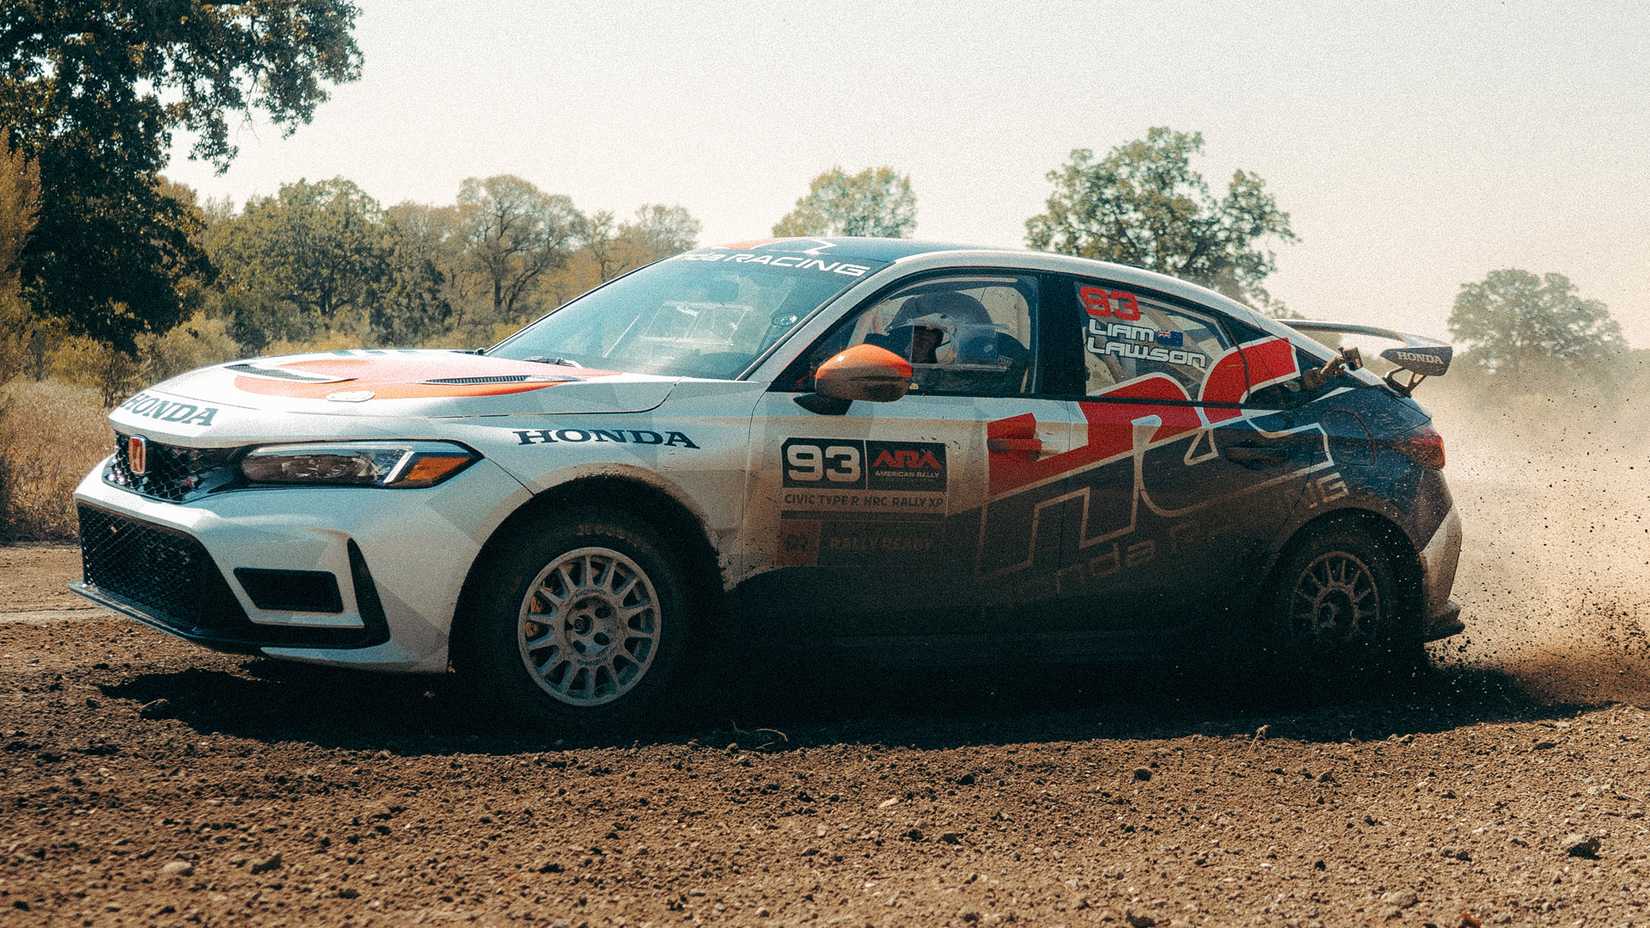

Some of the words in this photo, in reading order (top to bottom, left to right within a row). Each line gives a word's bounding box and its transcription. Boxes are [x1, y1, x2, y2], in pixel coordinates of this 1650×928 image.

[723, 253, 871, 277] RACING
[1080, 285, 1141, 322] 93
[1088, 319, 1156, 343] LIAM
[1087, 336, 1208, 368] LAWSON
[1397, 351, 1445, 366] HONDA
[119, 392, 219, 427] HONDA
[512, 428, 701, 450] HONDA
[787, 444, 861, 482] 93
[874, 470, 915, 478] AMERICAN
[916, 471, 940, 479] RALLY
[784, 493, 816, 505] CIVIC
[819, 495, 848, 506] TYPE
[851, 496, 860, 506] R
[864, 496, 887, 506] HRC
[893, 497, 925, 507] RALLY
[928, 498, 944, 508] XP
